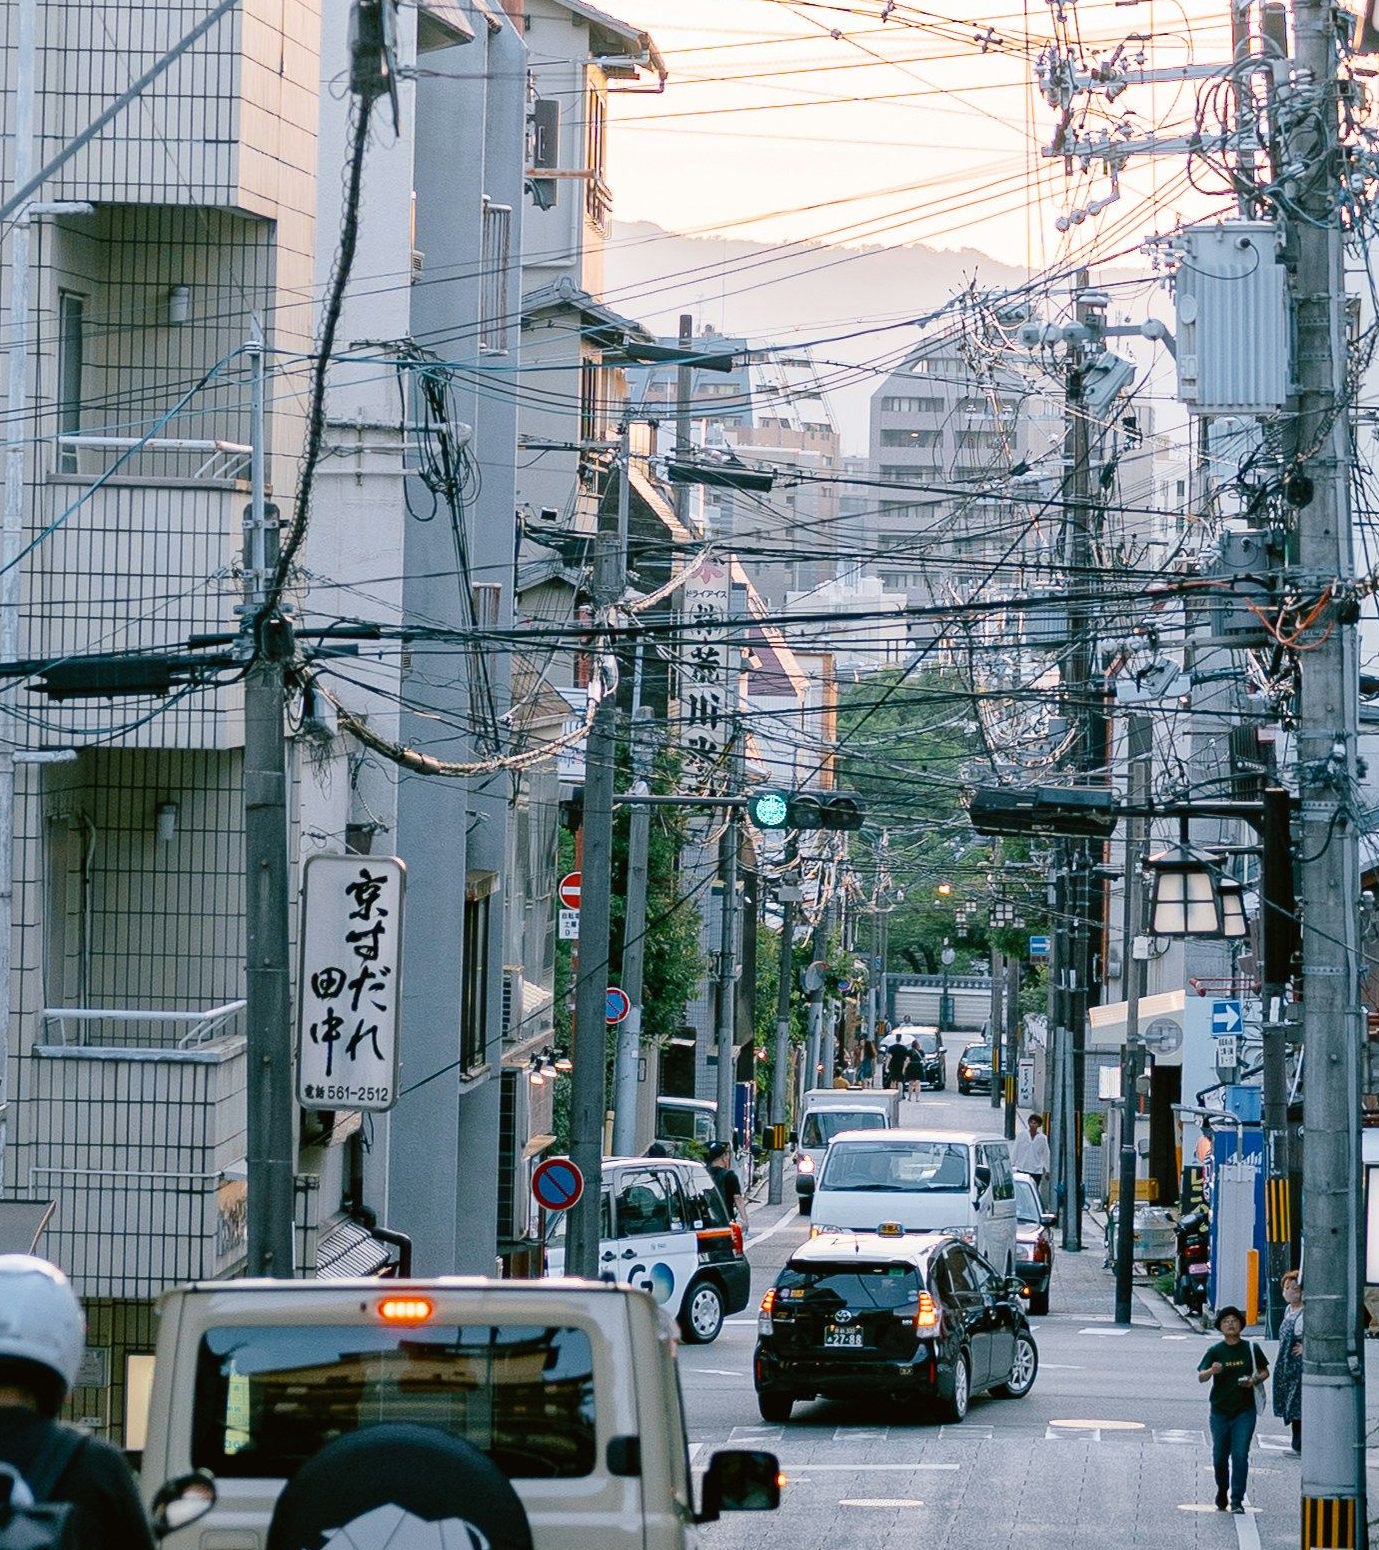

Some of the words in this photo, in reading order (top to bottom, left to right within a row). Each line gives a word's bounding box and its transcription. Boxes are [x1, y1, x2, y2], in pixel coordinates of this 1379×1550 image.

[345, 867, 391, 1061] 京すだれ
[310, 966, 347, 1077] 田中
[327, 1085, 389, 1101] 561-2512
